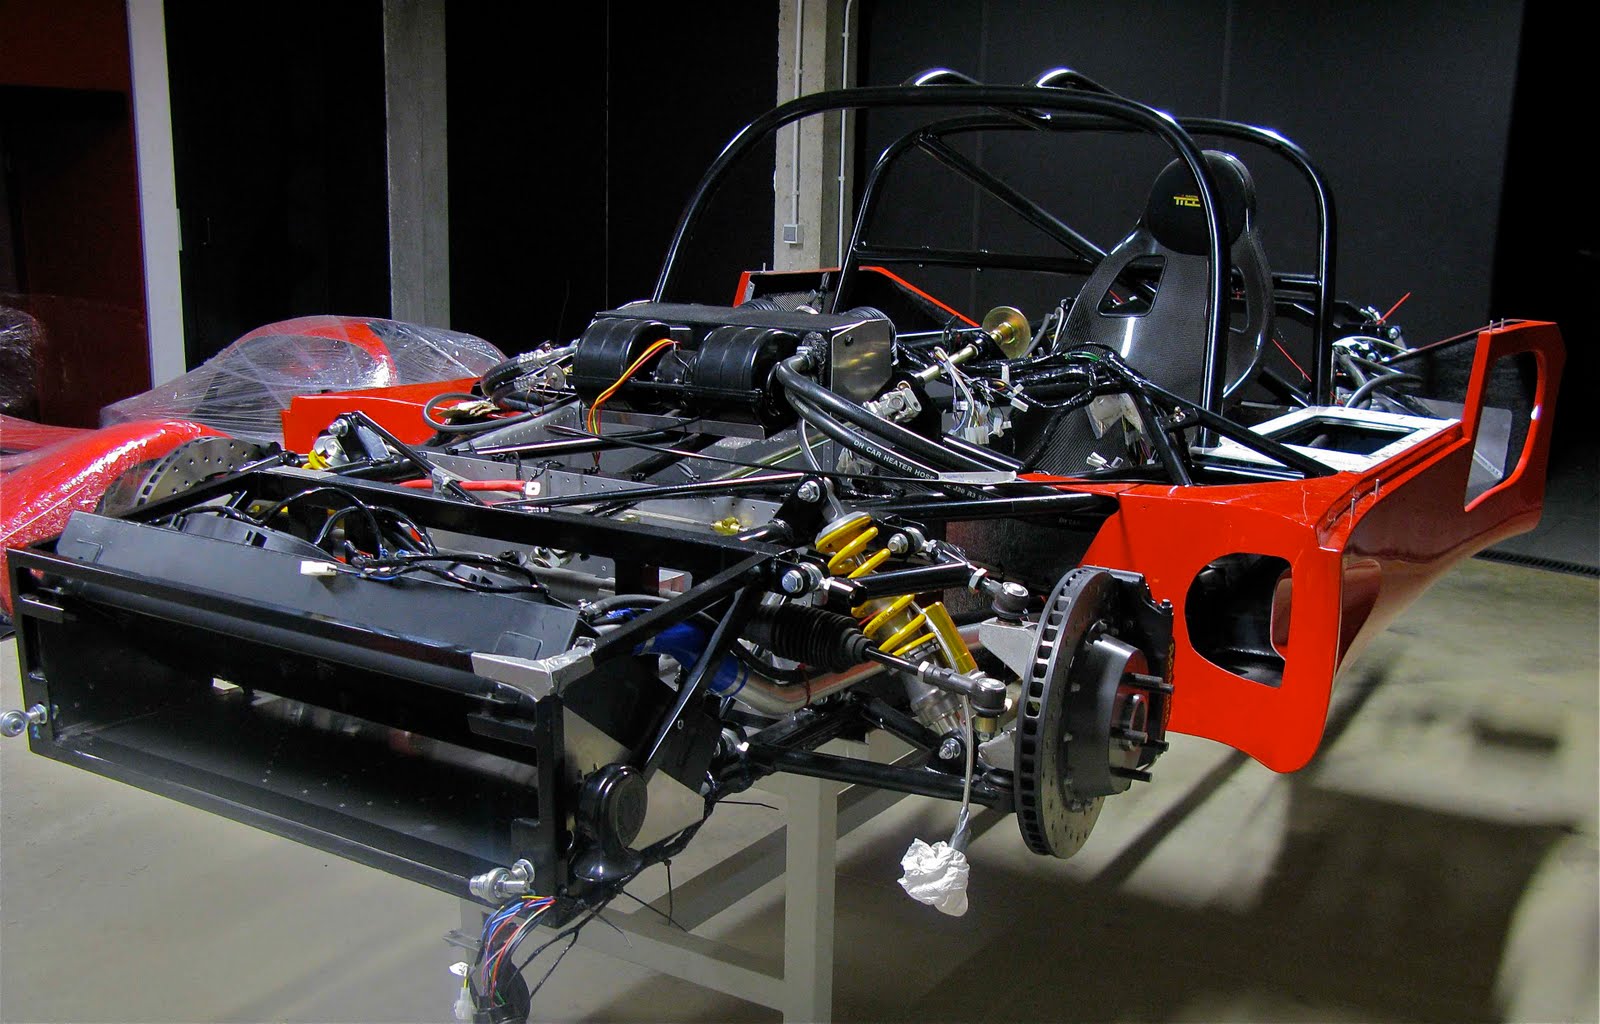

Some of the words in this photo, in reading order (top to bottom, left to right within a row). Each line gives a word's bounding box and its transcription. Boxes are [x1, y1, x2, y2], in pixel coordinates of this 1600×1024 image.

[853, 439, 865, 449] DH
[866, 446, 882, 458] CAR
[883, 454, 913, 472] HEATER
